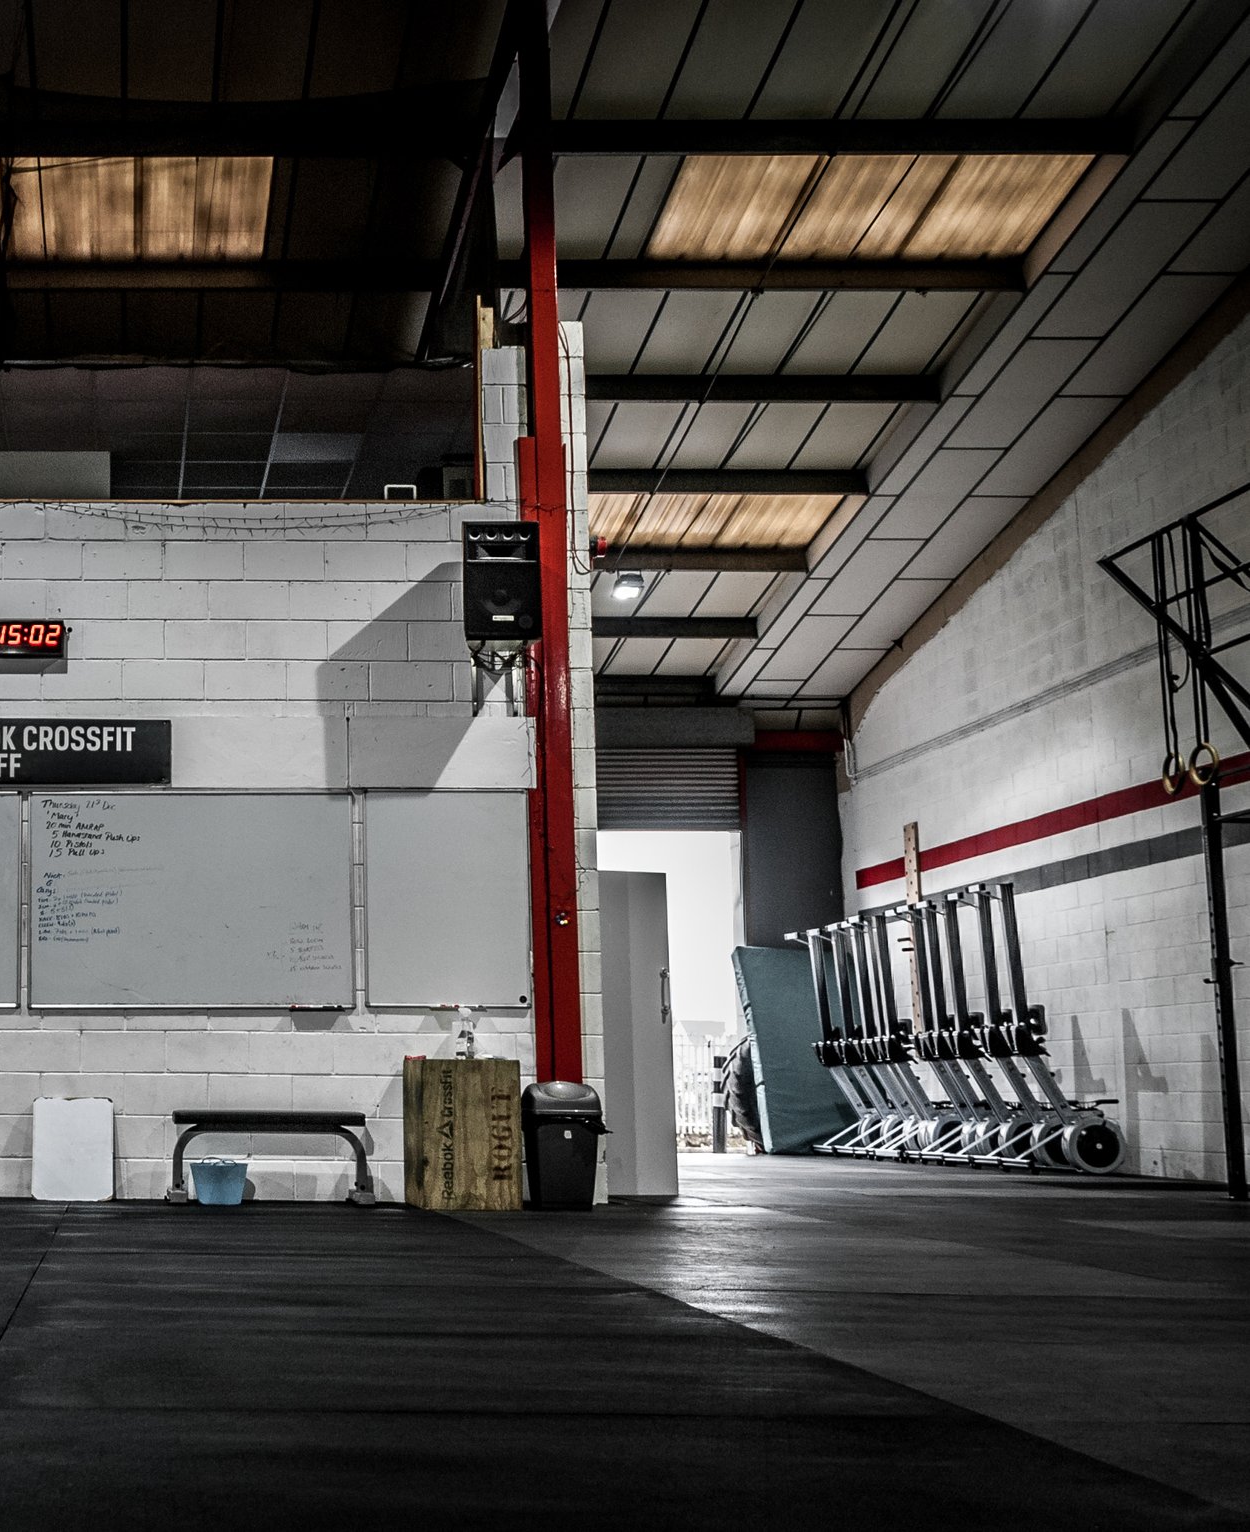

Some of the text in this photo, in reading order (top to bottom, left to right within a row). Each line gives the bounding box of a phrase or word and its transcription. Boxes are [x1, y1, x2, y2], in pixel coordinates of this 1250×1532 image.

[22, 725, 136, 752] CROSSFIT
[51, 830, 59, 839] 5
[105, 831, 125, 842] Push
[50, 840, 61, 848] 10
[49, 848, 62, 858] 15
[68, 848, 85, 856] Pull
[440, 1069, 454, 1200] Reebok CrossFit
